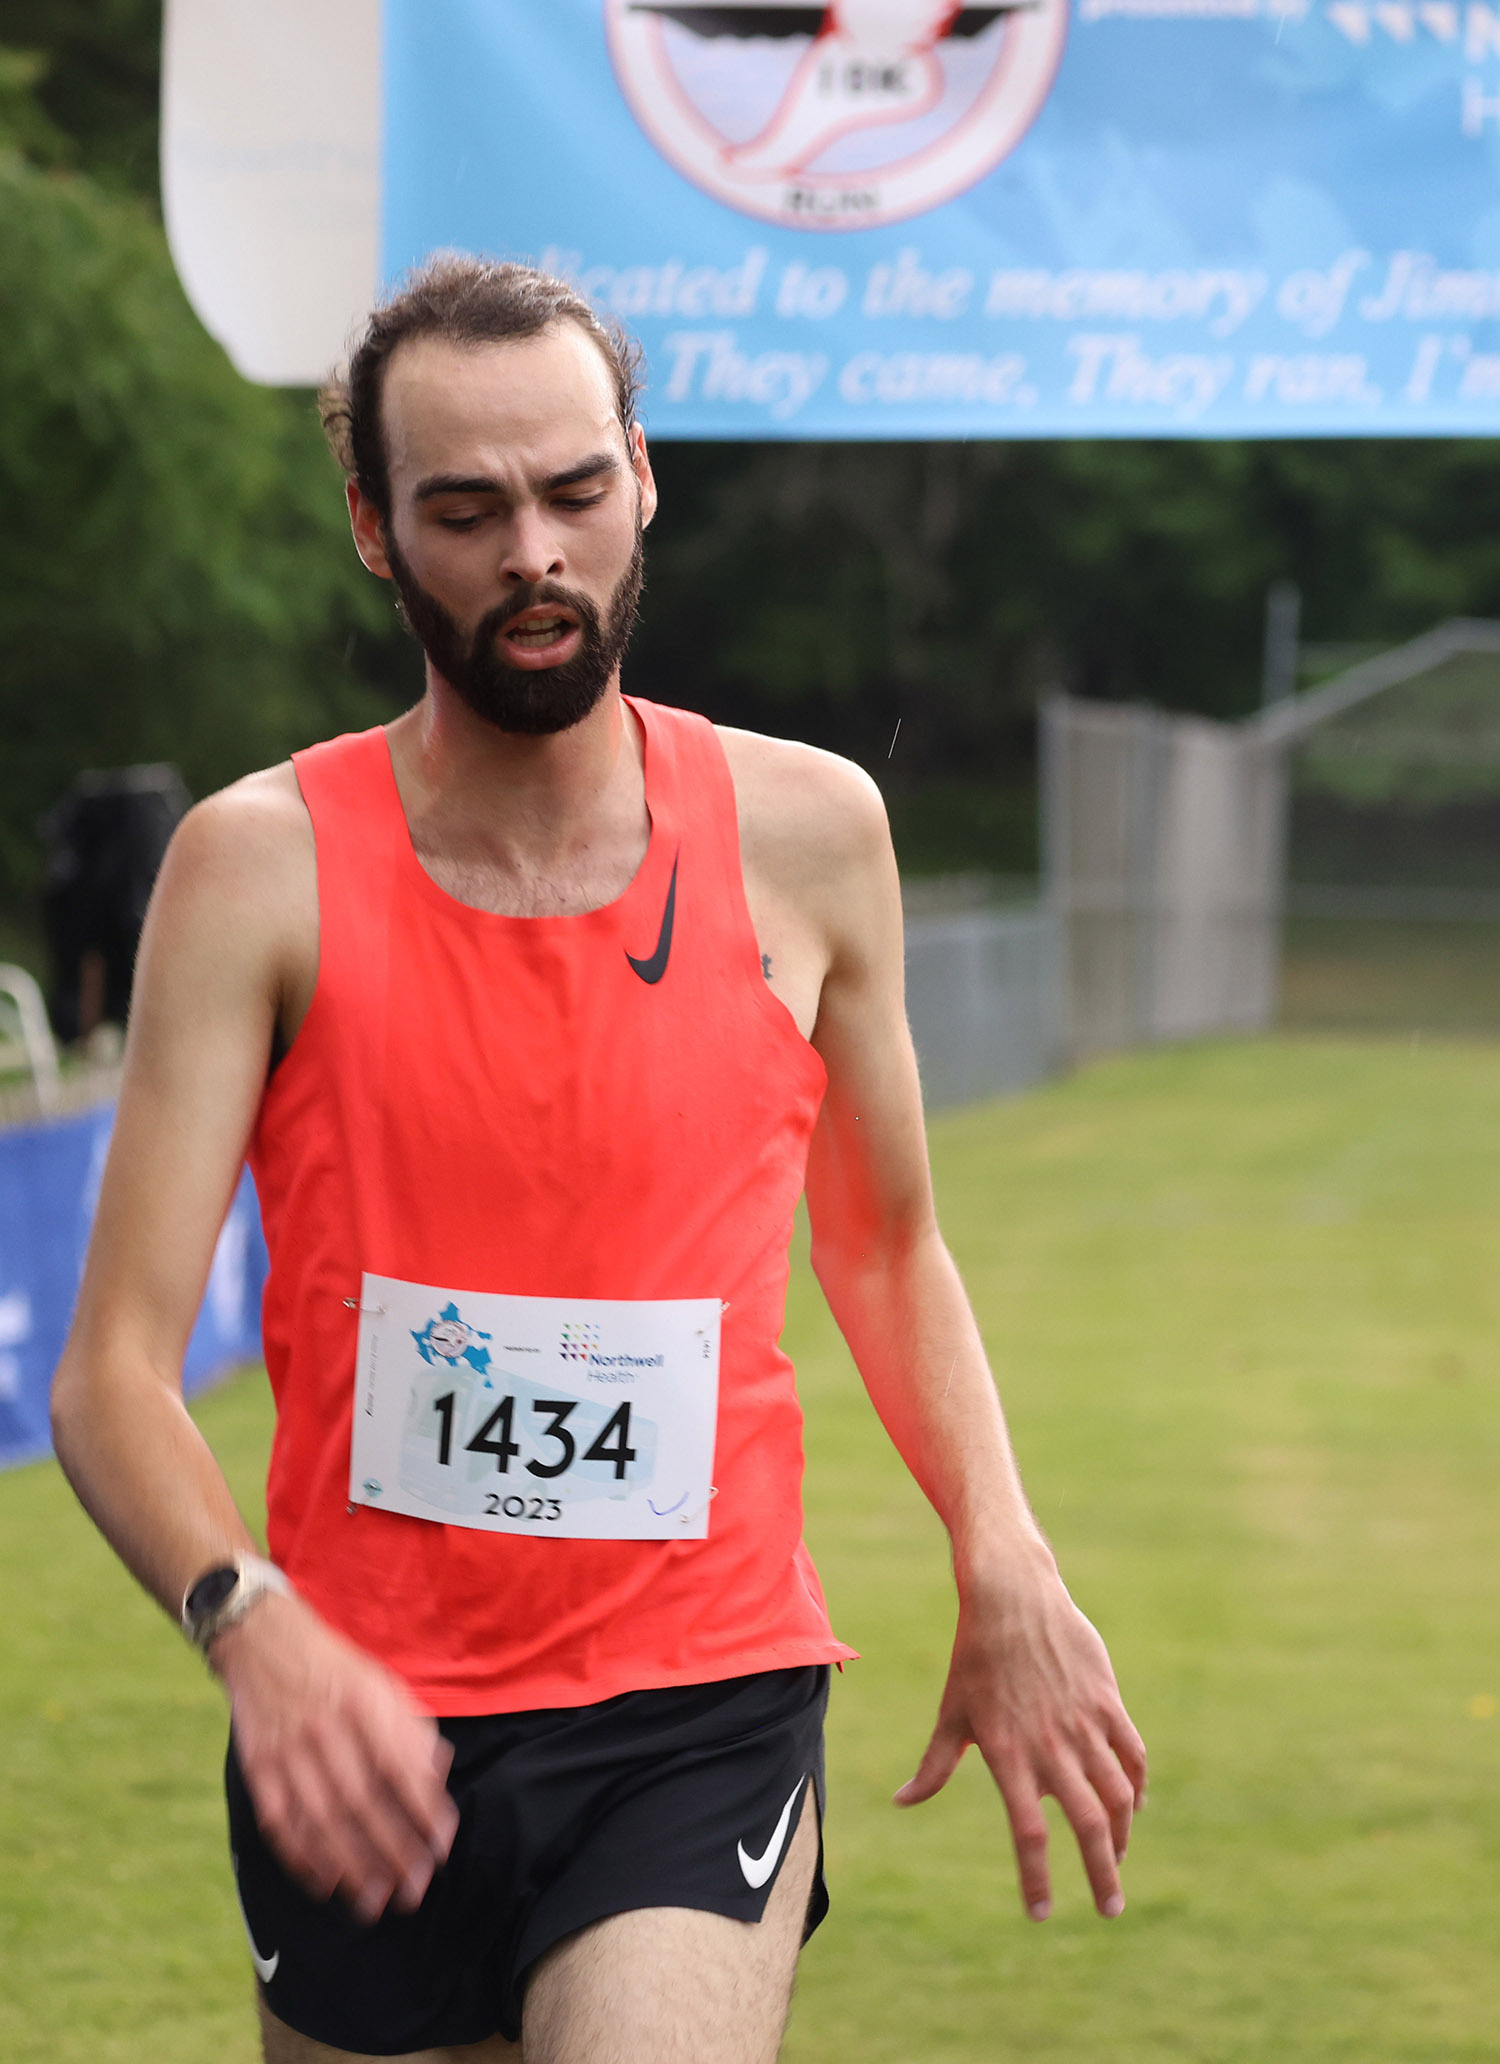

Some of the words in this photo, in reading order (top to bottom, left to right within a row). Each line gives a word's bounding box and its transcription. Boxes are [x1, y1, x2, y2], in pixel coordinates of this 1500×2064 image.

[776, 260, 849, 319] to
[862, 248, 974, 319] the
[986, 268, 1269, 337] memory
[1277, 248, 1372, 338] of
[663, 331, 830, 420] They
[1065, 333, 1234, 420] They
[586, 1370, 637, 1384] Health
[588, 1354, 665, 1368] Northwell
[433, 1391, 637, 1480] 1434
[483, 1493, 562, 1522] 2023
